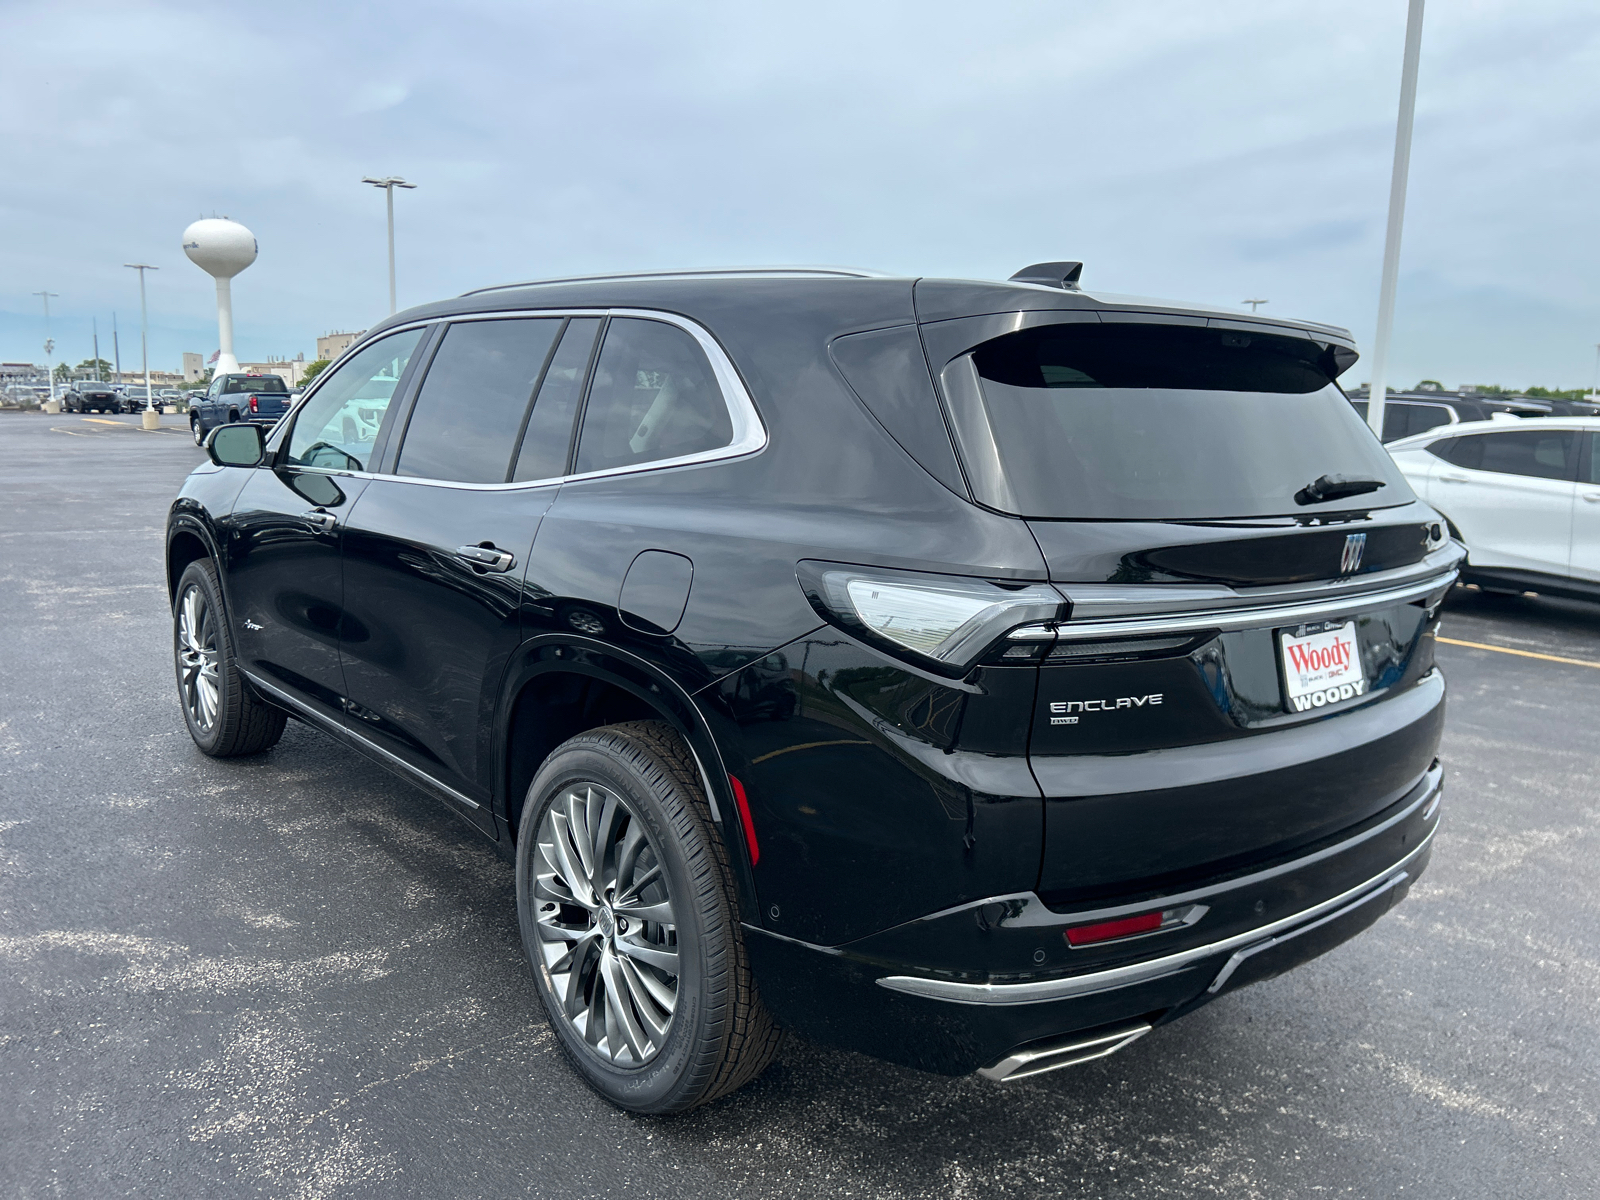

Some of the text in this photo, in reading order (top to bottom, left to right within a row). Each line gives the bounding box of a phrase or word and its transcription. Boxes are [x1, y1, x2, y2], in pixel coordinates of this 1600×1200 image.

[1287, 636, 1351, 674] Woody
[1050, 693, 1163, 713] ENCLAVE
[1293, 680, 1364, 712] WOODY
[584, 756, 665, 849] CONTINENTAL
